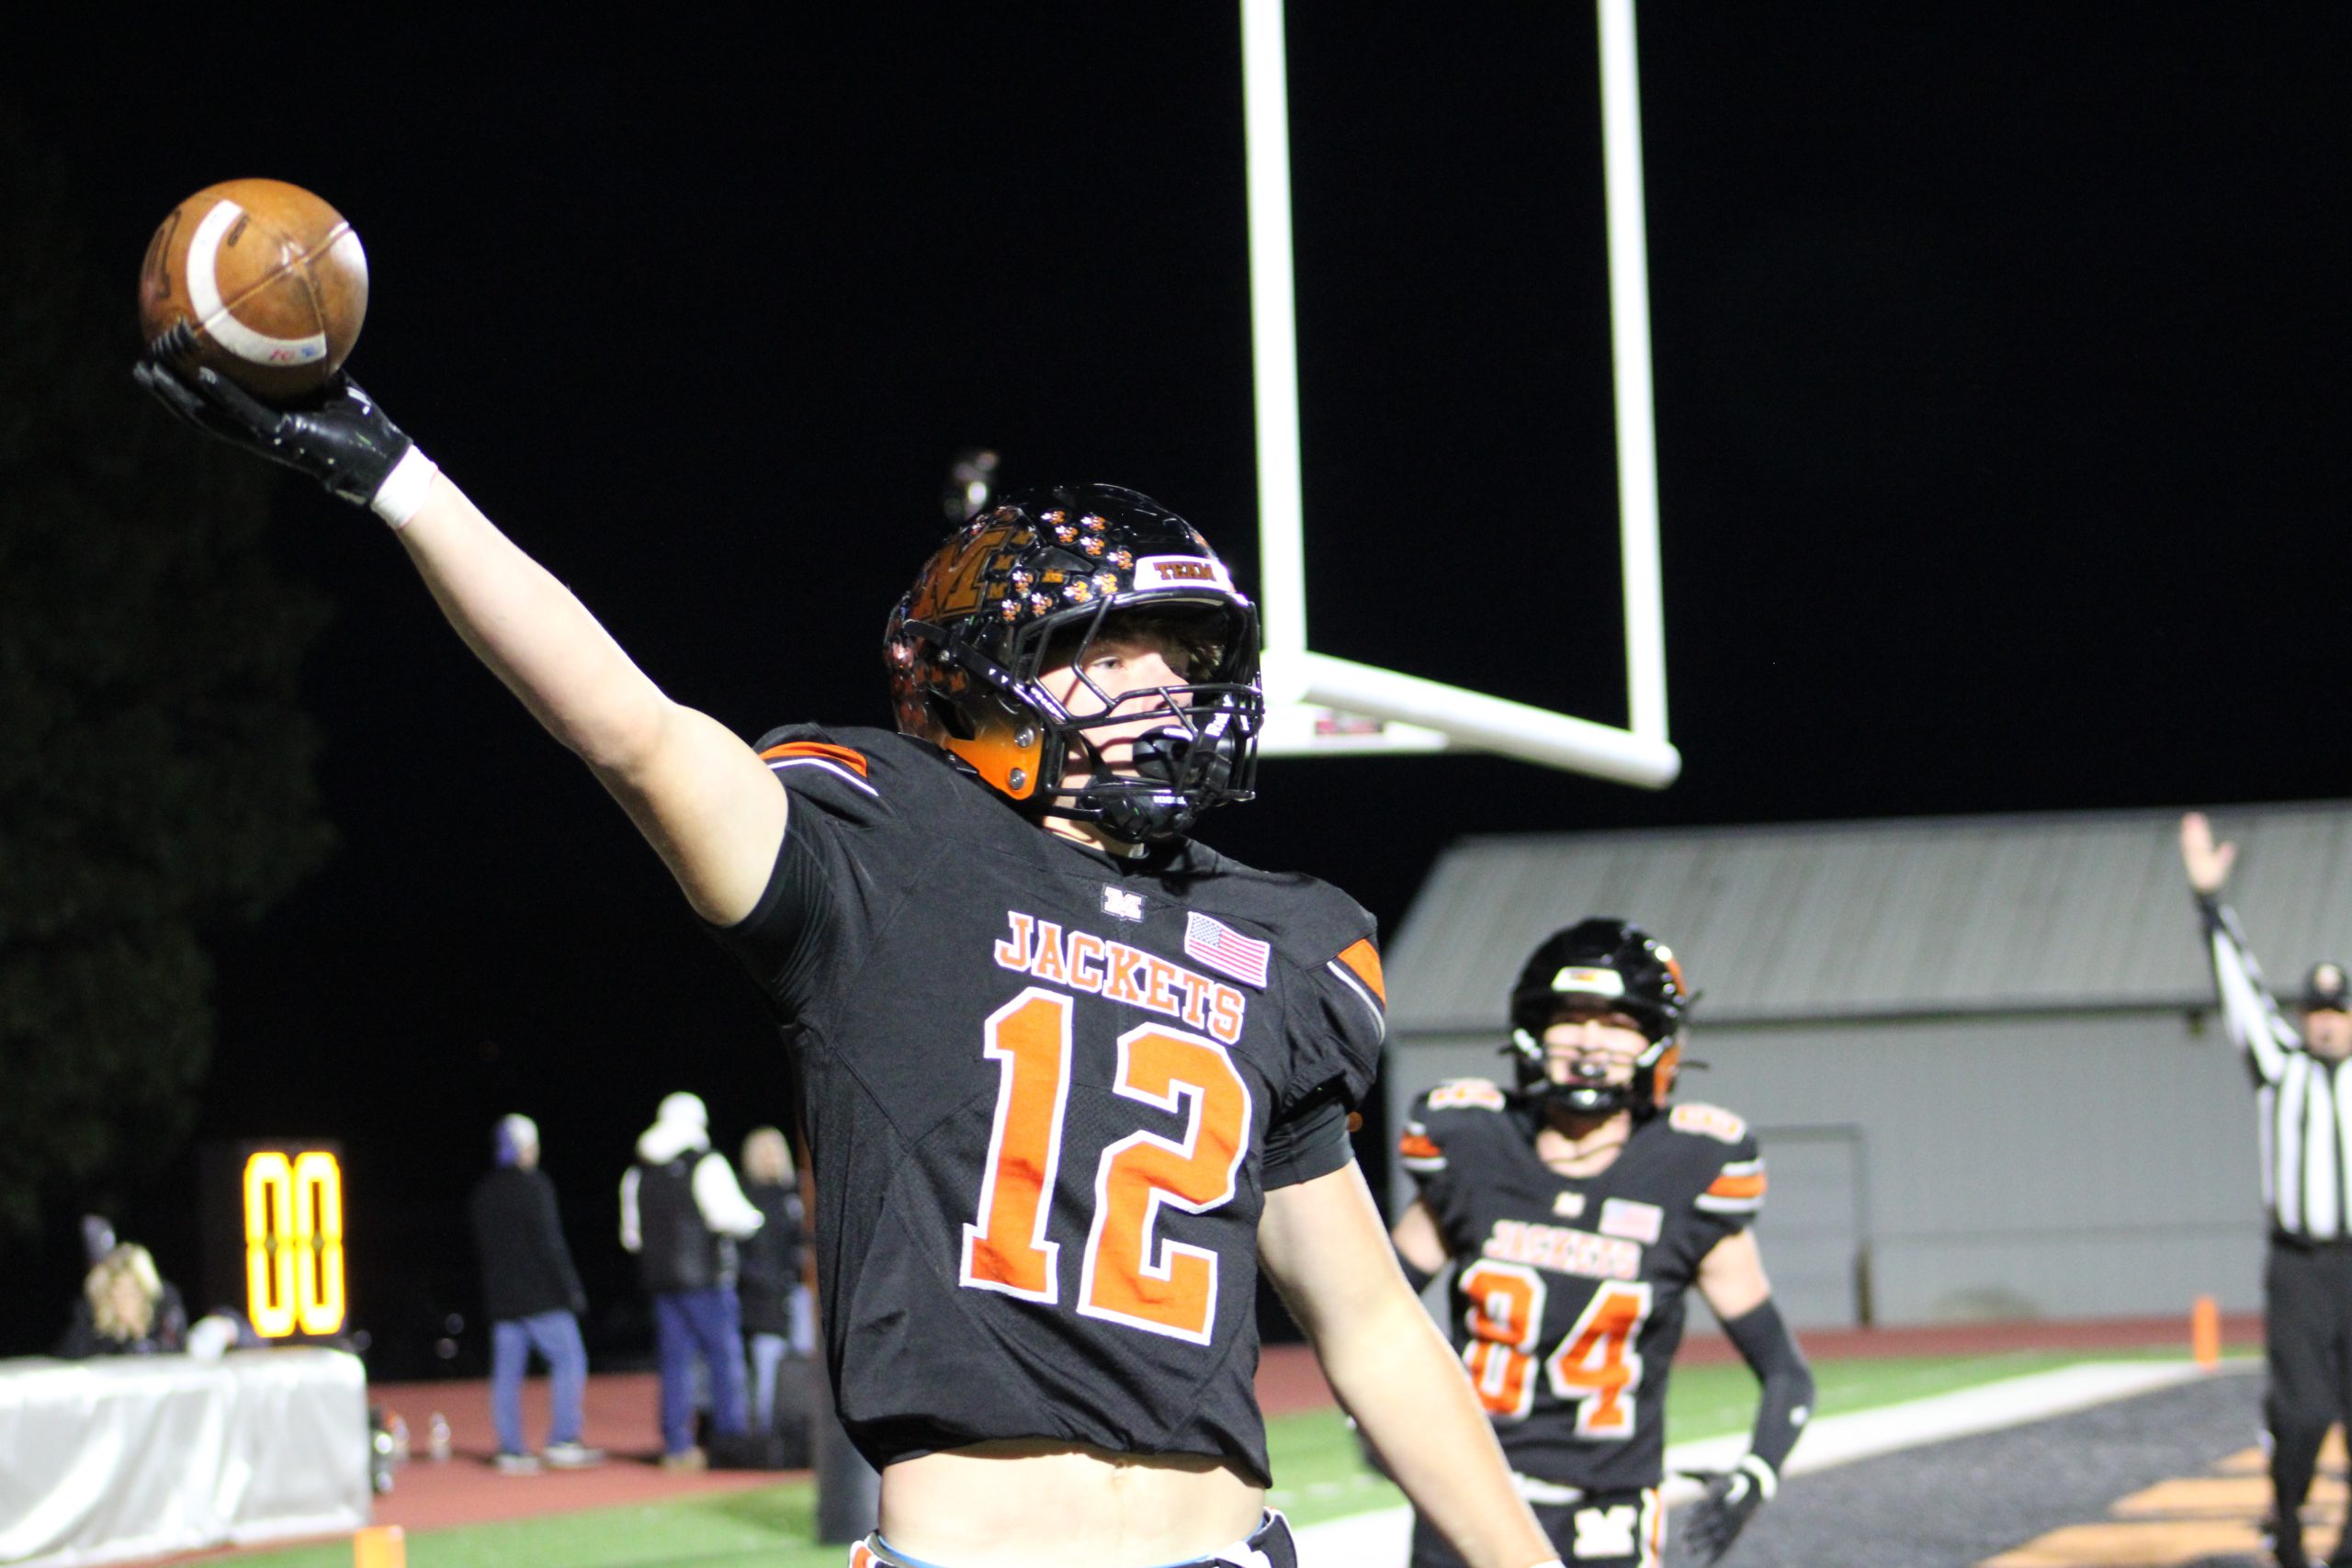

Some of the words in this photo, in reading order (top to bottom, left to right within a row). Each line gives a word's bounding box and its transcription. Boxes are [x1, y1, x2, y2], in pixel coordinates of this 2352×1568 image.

[1152, 560, 1217, 582] TEAM
[1102, 885, 1145, 920] M
[994, 910, 1246, 1045] JACKETS
[959, 987, 1252, 1347] 12
[243, 1151, 345, 1337] 00
[1459, 1258, 1653, 1440] 84
[1574, 1505, 1638, 1557] M
